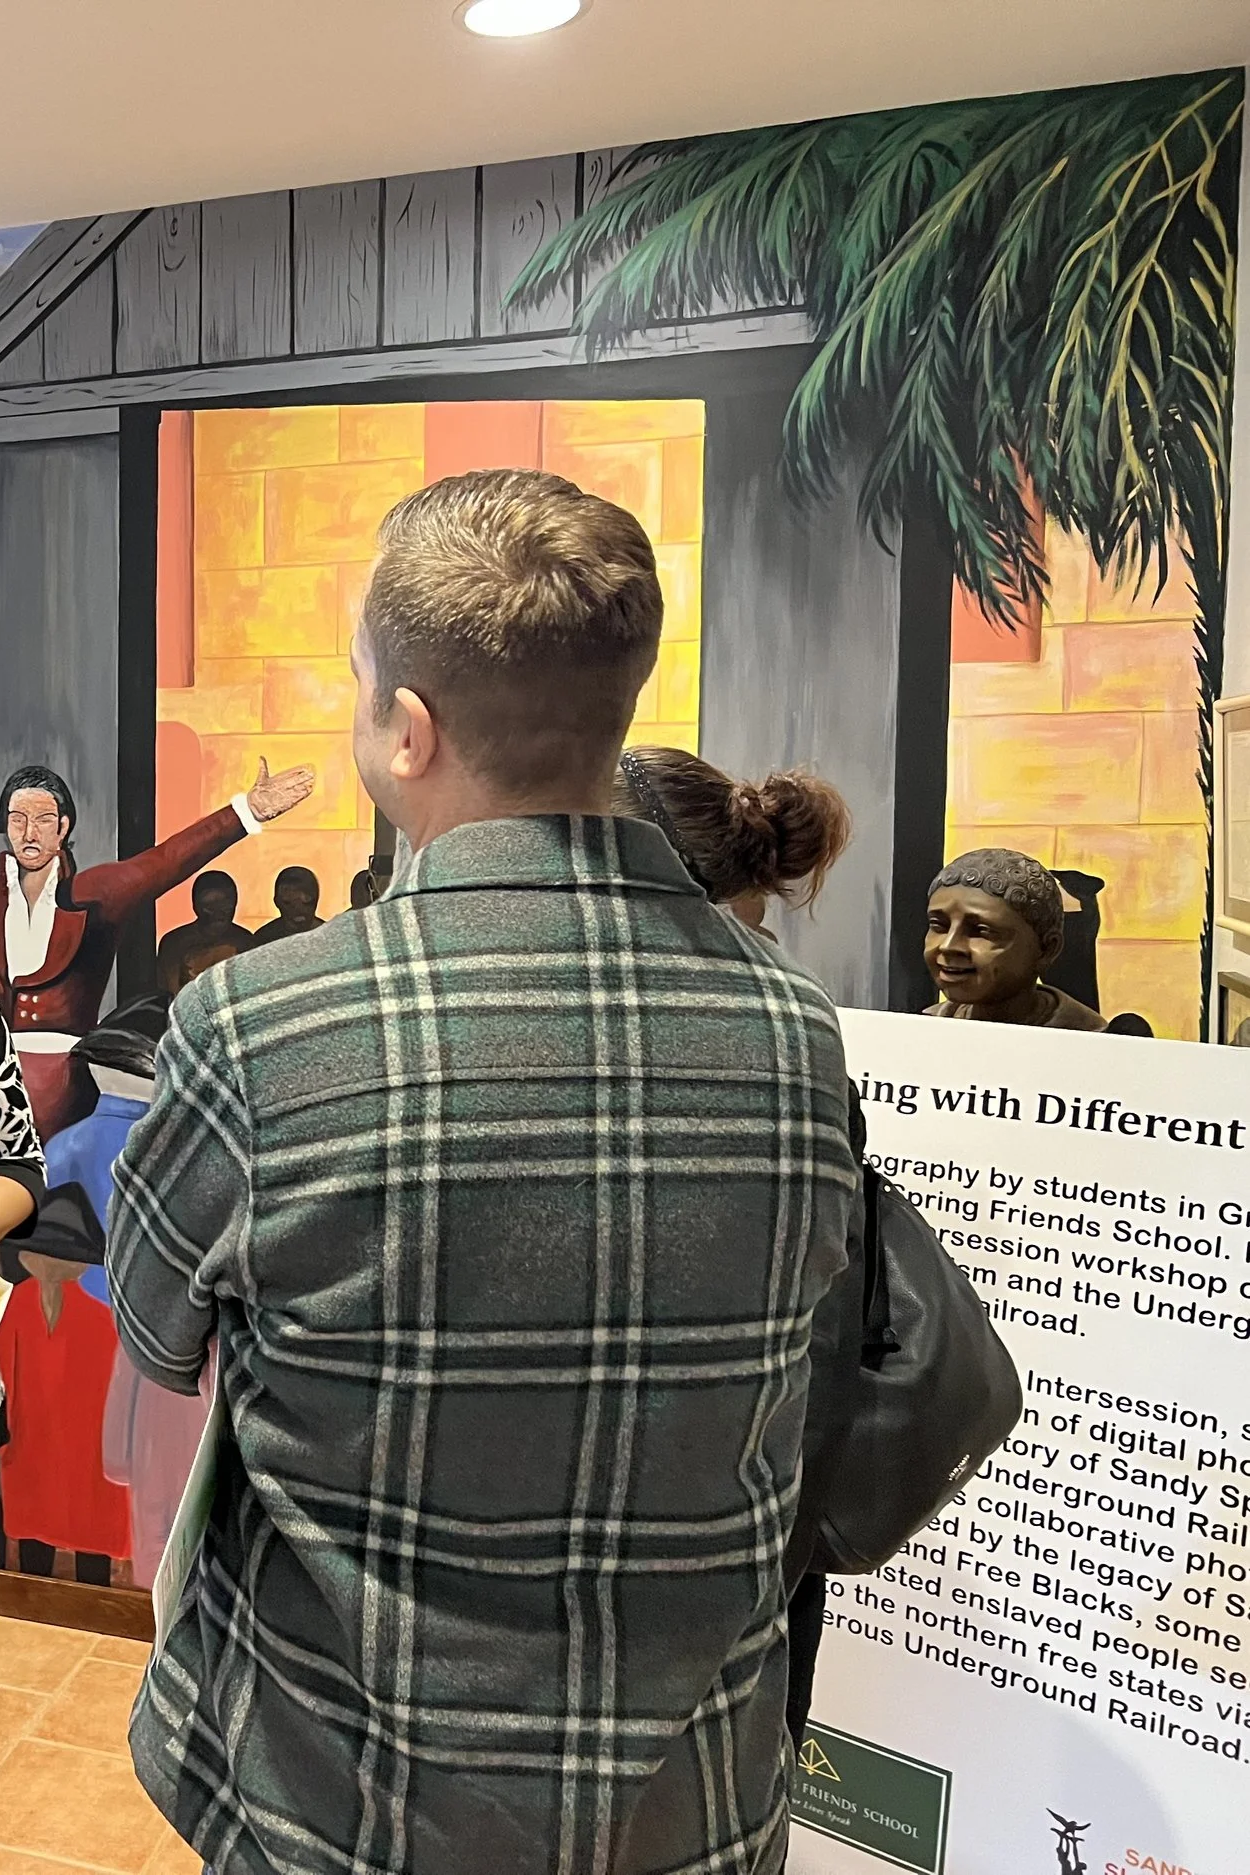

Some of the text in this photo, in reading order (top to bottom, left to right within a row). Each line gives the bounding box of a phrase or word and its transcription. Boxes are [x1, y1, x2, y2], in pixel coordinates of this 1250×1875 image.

[858, 1072, 1247, 1149] ing with Different
[868, 1153, 980, 1189] ography
[989, 1167, 1024, 1196] by
[1033, 1176, 1167, 1213] students
[1179, 1195, 1205, 1220] in
[929, 1226, 1060, 1265] rsession
[1072, 1250, 1228, 1299] workshop
[990, 1200, 1101, 1237] Friends
[1113, 1220, 1231, 1260] School.
[1007, 1271, 1063, 1298] and
[1073, 1281, 1121, 1309] the
[1026, 1369, 1229, 1439] Intersession,
[1050, 1413, 1083, 1437] of
[1090, 1421, 1186, 1462] digital
[1002, 1436, 1059, 1468] tory
[1070, 1450, 1102, 1475] of
[1109, 1459, 1209, 1505] Sandy
[969, 1521, 1003, 1553] by
[1013, 1534, 1059, 1566] the
[1070, 1550, 1173, 1601] legacy
[1183, 1586, 1217, 1609] of
[977, 1496, 1176, 1564] collaborative
[1186, 1549, 1250, 1583] pho
[1187, 1512, 1248, 1548] Rail
[898, 1541, 1242, 1652] and Free Blacks, some
[854, 1584, 895, 1614] the
[905, 1604, 1028, 1658] northern
[1038, 1642, 1098, 1679] free
[1108, 1670, 1204, 1713] states
[951, 1586, 1082, 1641] enslaved
[1092, 1627, 1199, 1676] people
[1210, 1661, 1250, 1690] se
[823, 1609, 1250, 1765] erous Underground Railroad.
[802, 1782, 919, 1839] FRIENDS SCHOOL
